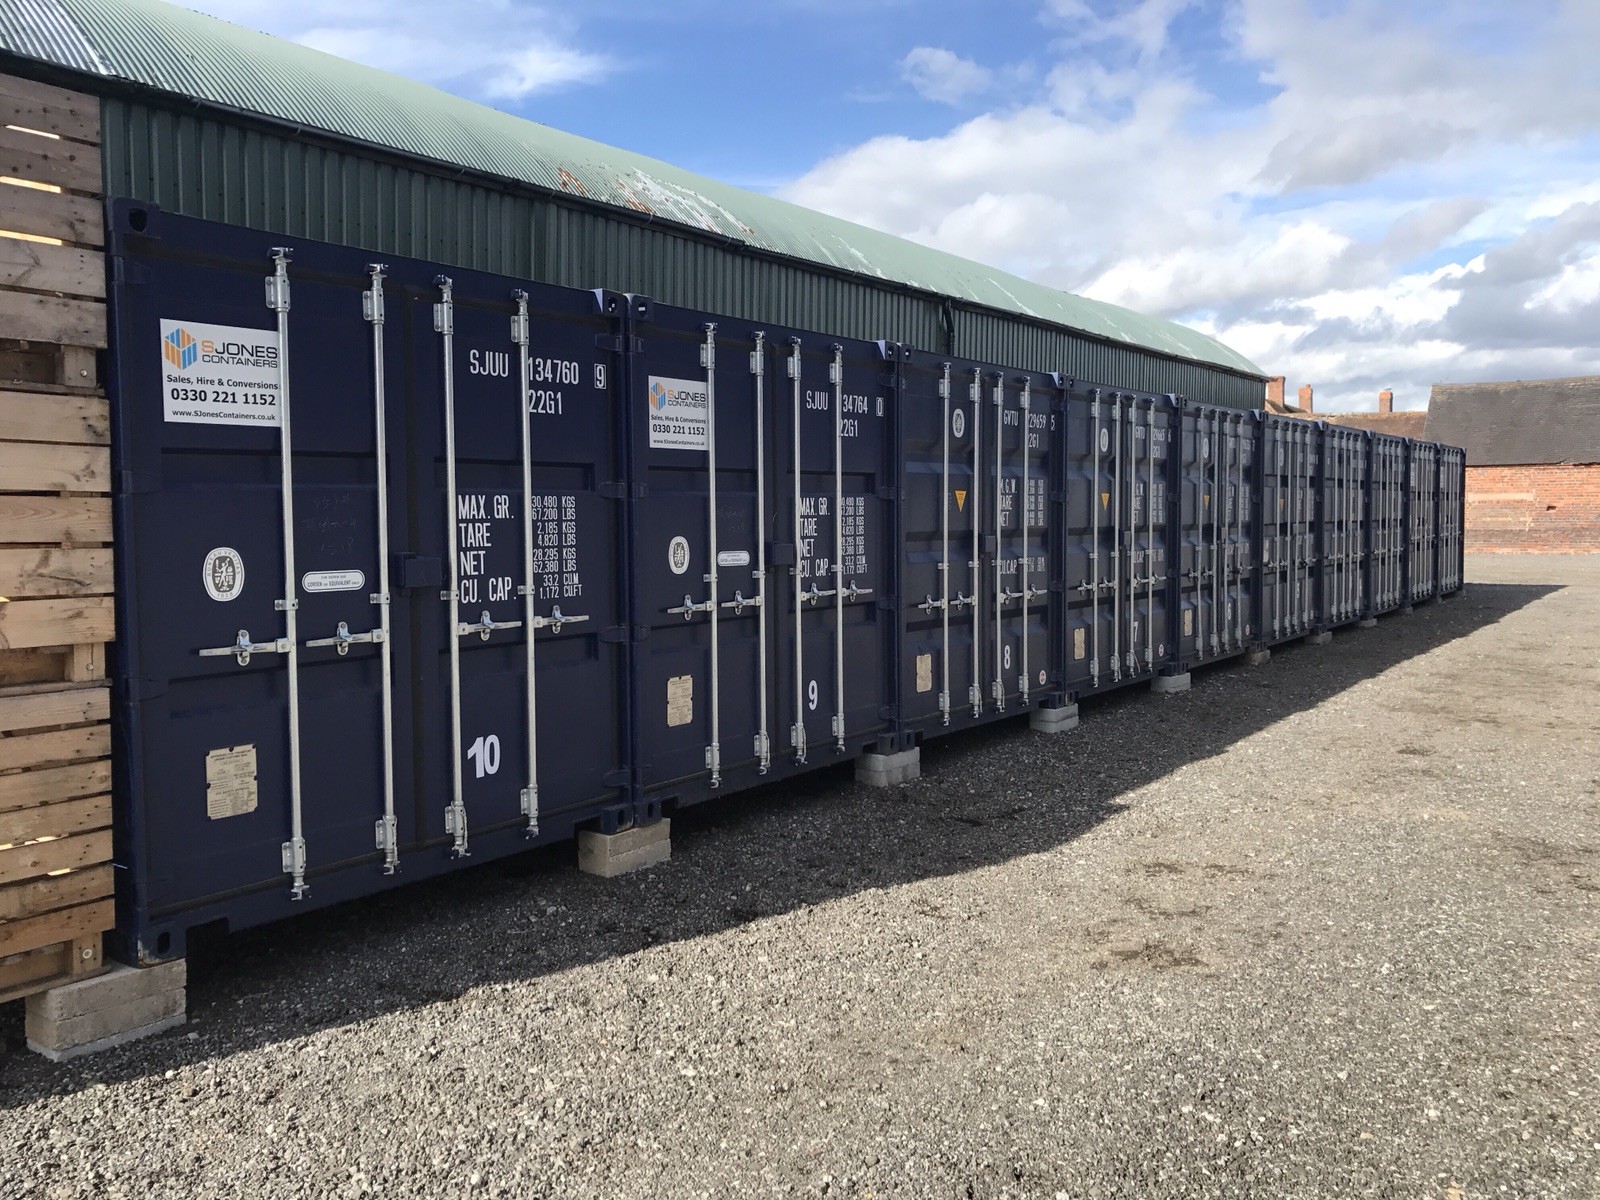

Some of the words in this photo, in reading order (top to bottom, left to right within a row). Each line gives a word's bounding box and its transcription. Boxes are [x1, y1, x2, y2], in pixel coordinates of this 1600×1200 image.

[202, 340, 277, 358] SJONES
[202, 355, 278, 368] CONTAINERS
[470, 349, 509, 377] SJUU
[528, 357, 579, 384] 134760
[595, 365, 605, 388] 9
[167, 374, 194, 385] Sales,
[197, 377, 215, 385] Hire
[227, 379, 278, 390] Conversions
[171, 388, 207, 402] 0330
[212, 391, 238, 403] 221
[243, 393, 276, 405] 1152
[529, 390, 562, 414] 22G1
[668, 390, 706, 402] SJONES
[668, 400, 706, 409] CONTAINERS
[806, 390, 828, 411] SJUU
[842, 394, 868, 414] 34764
[172, 409, 276, 420] www.SJonesContainers.co.uk
[1004, 410, 1018, 426] GVTU
[1028, 414, 1046, 428] 29659
[653, 424, 670, 433] 0330
[673, 426, 685, 434] 221
[688, 427, 705, 435] 1152
[1028, 434, 1039, 448] 2G1
[458, 495, 490, 519] MAX.
[494, 495, 514, 519] GR.
[562, 496, 575, 507] KGS
[819, 498, 830, 515] GR.
[562, 509, 575, 519] LBS
[459, 522, 491, 548] TARE
[562, 522, 576, 533] KGS
[800, 518, 817, 536] TARE
[563, 534, 576, 545] LBS
[800, 539, 814, 557] NET
[563, 548, 576, 559] KGS
[460, 551, 485, 576] NET
[563, 560, 576, 571] LBS
[816, 559, 831, 576] CAP.
[543, 574, 559, 586] 33.2
[461, 580, 481, 604] CU.
[489, 577, 516, 601] CAP.
[1134, 622, 1138, 642] 7
[1004, 645, 1010, 669] 8
[809, 680, 818, 711] 9
[468, 734, 500, 778] 10
